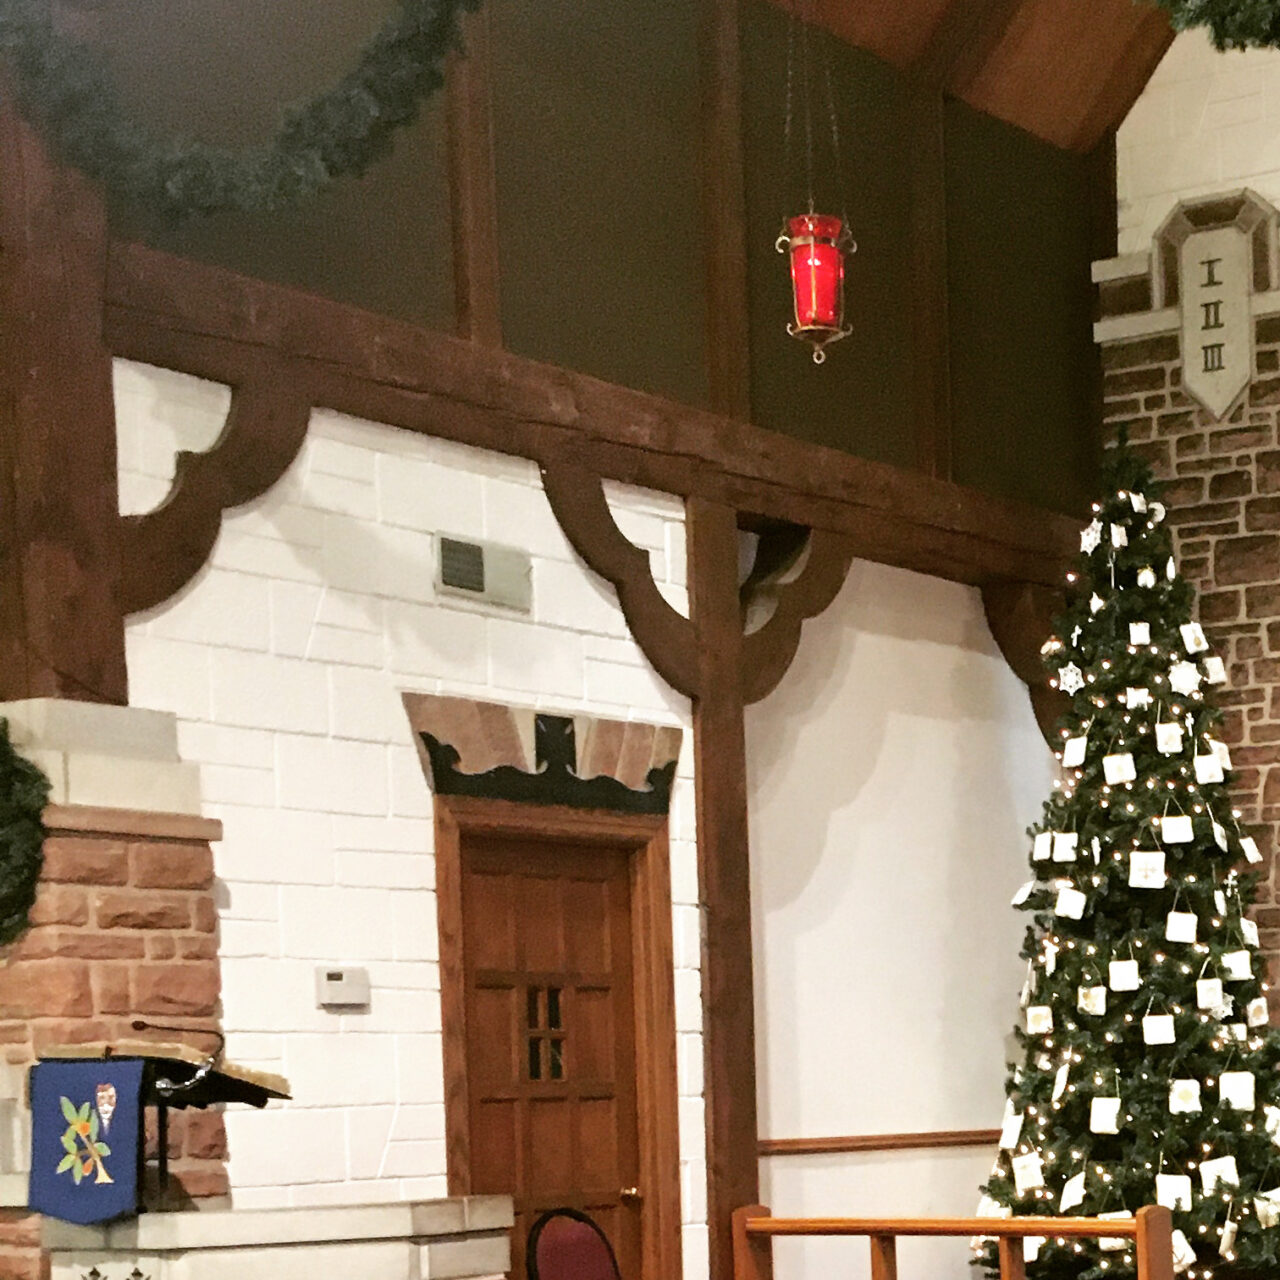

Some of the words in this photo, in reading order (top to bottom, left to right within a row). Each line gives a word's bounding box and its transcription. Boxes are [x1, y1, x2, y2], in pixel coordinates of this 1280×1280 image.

[1199, 258, 1223, 287] I
[1200, 300, 1224, 330] II
[1201, 343, 1225, 373] III
